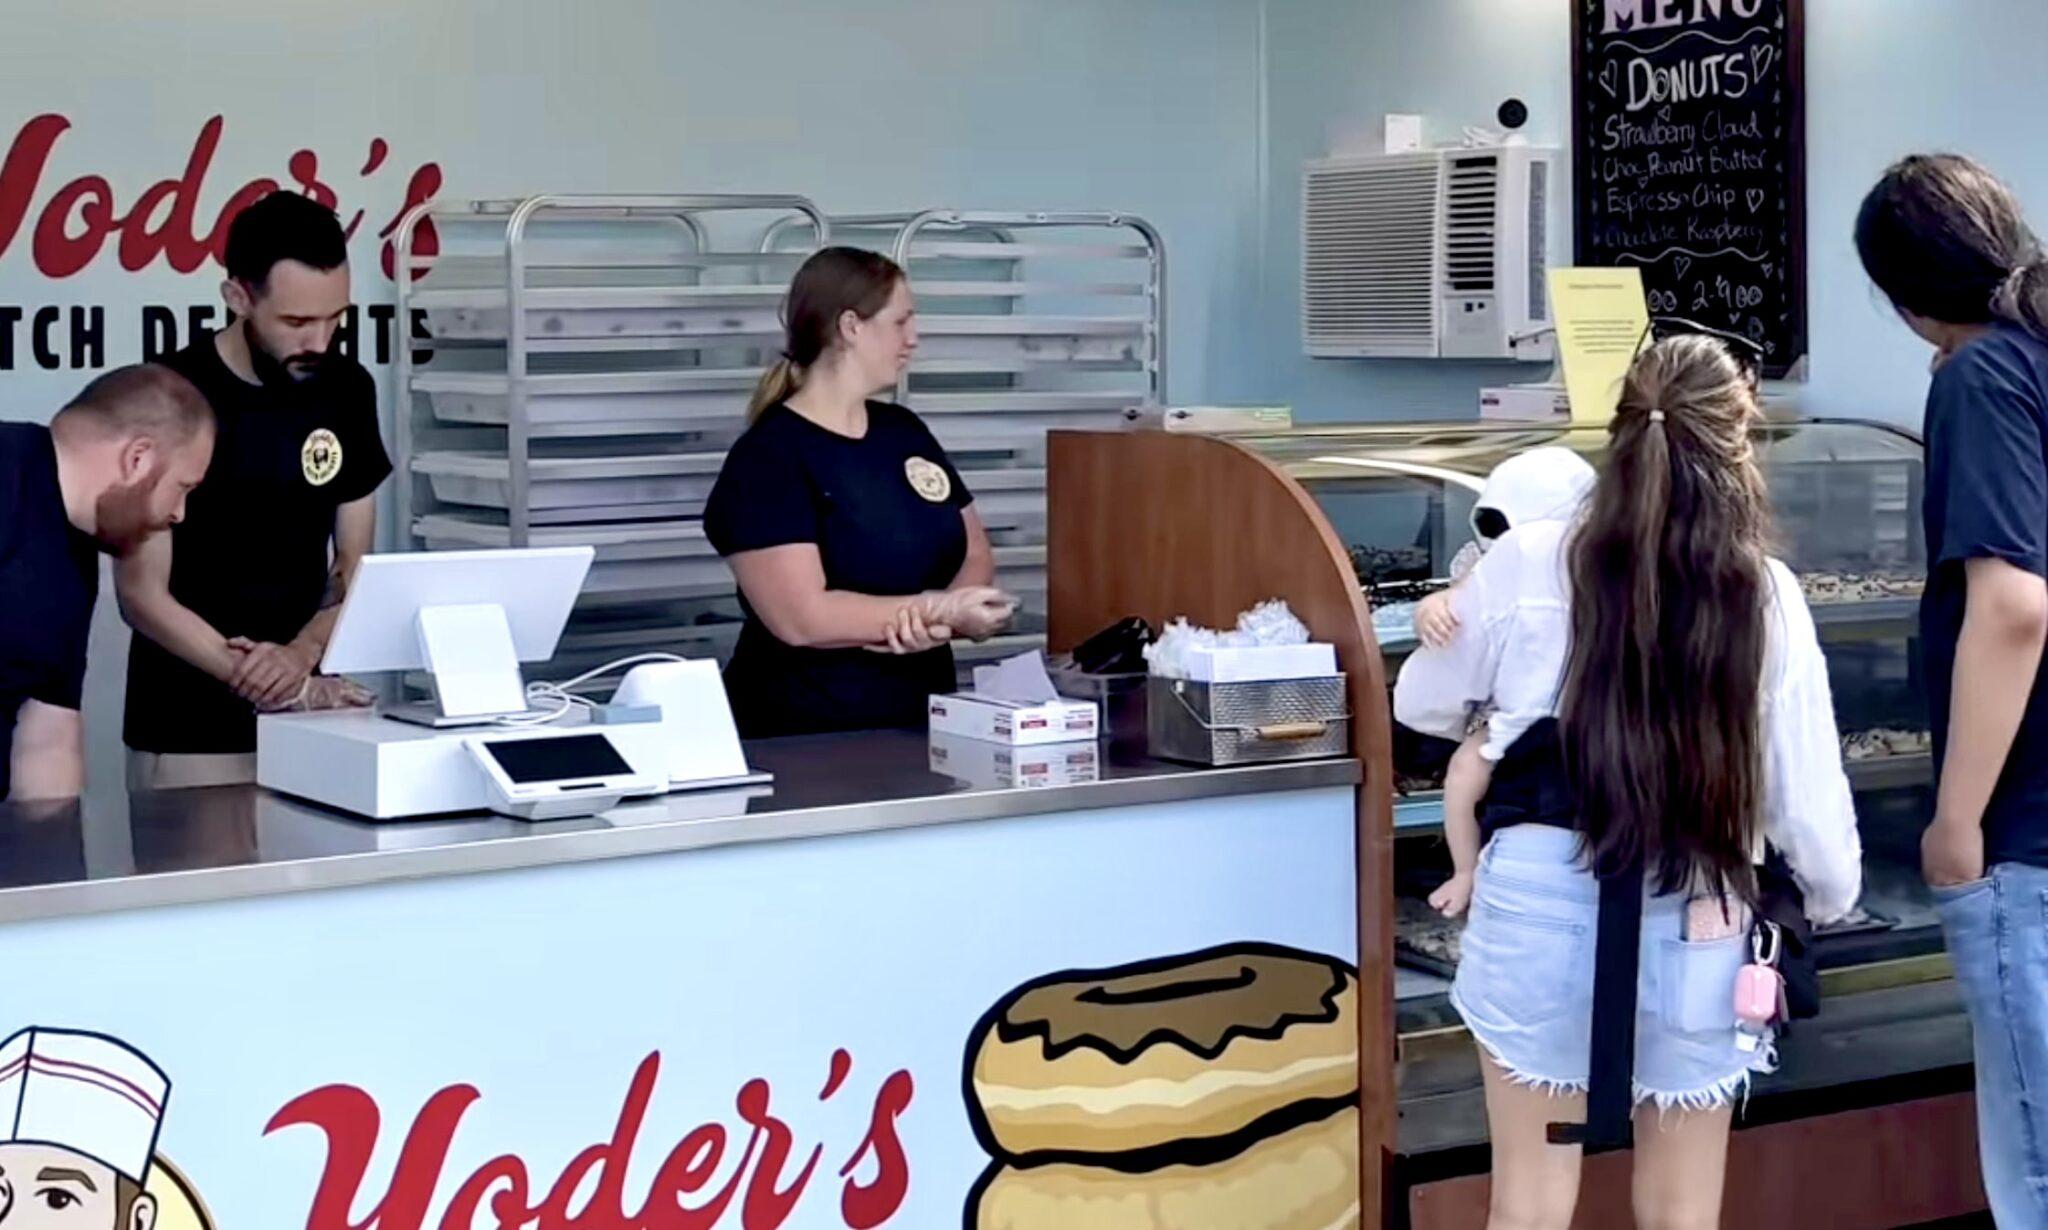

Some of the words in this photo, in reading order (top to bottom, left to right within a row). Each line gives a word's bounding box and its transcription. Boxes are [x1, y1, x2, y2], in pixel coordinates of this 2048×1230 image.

[1625, 53, 1748, 111] DONUTS
[1702, 109, 1762, 143] Cloud
[1692, 182, 1736, 210] Chip
[262, 1047, 913, 1230] Yoder's
